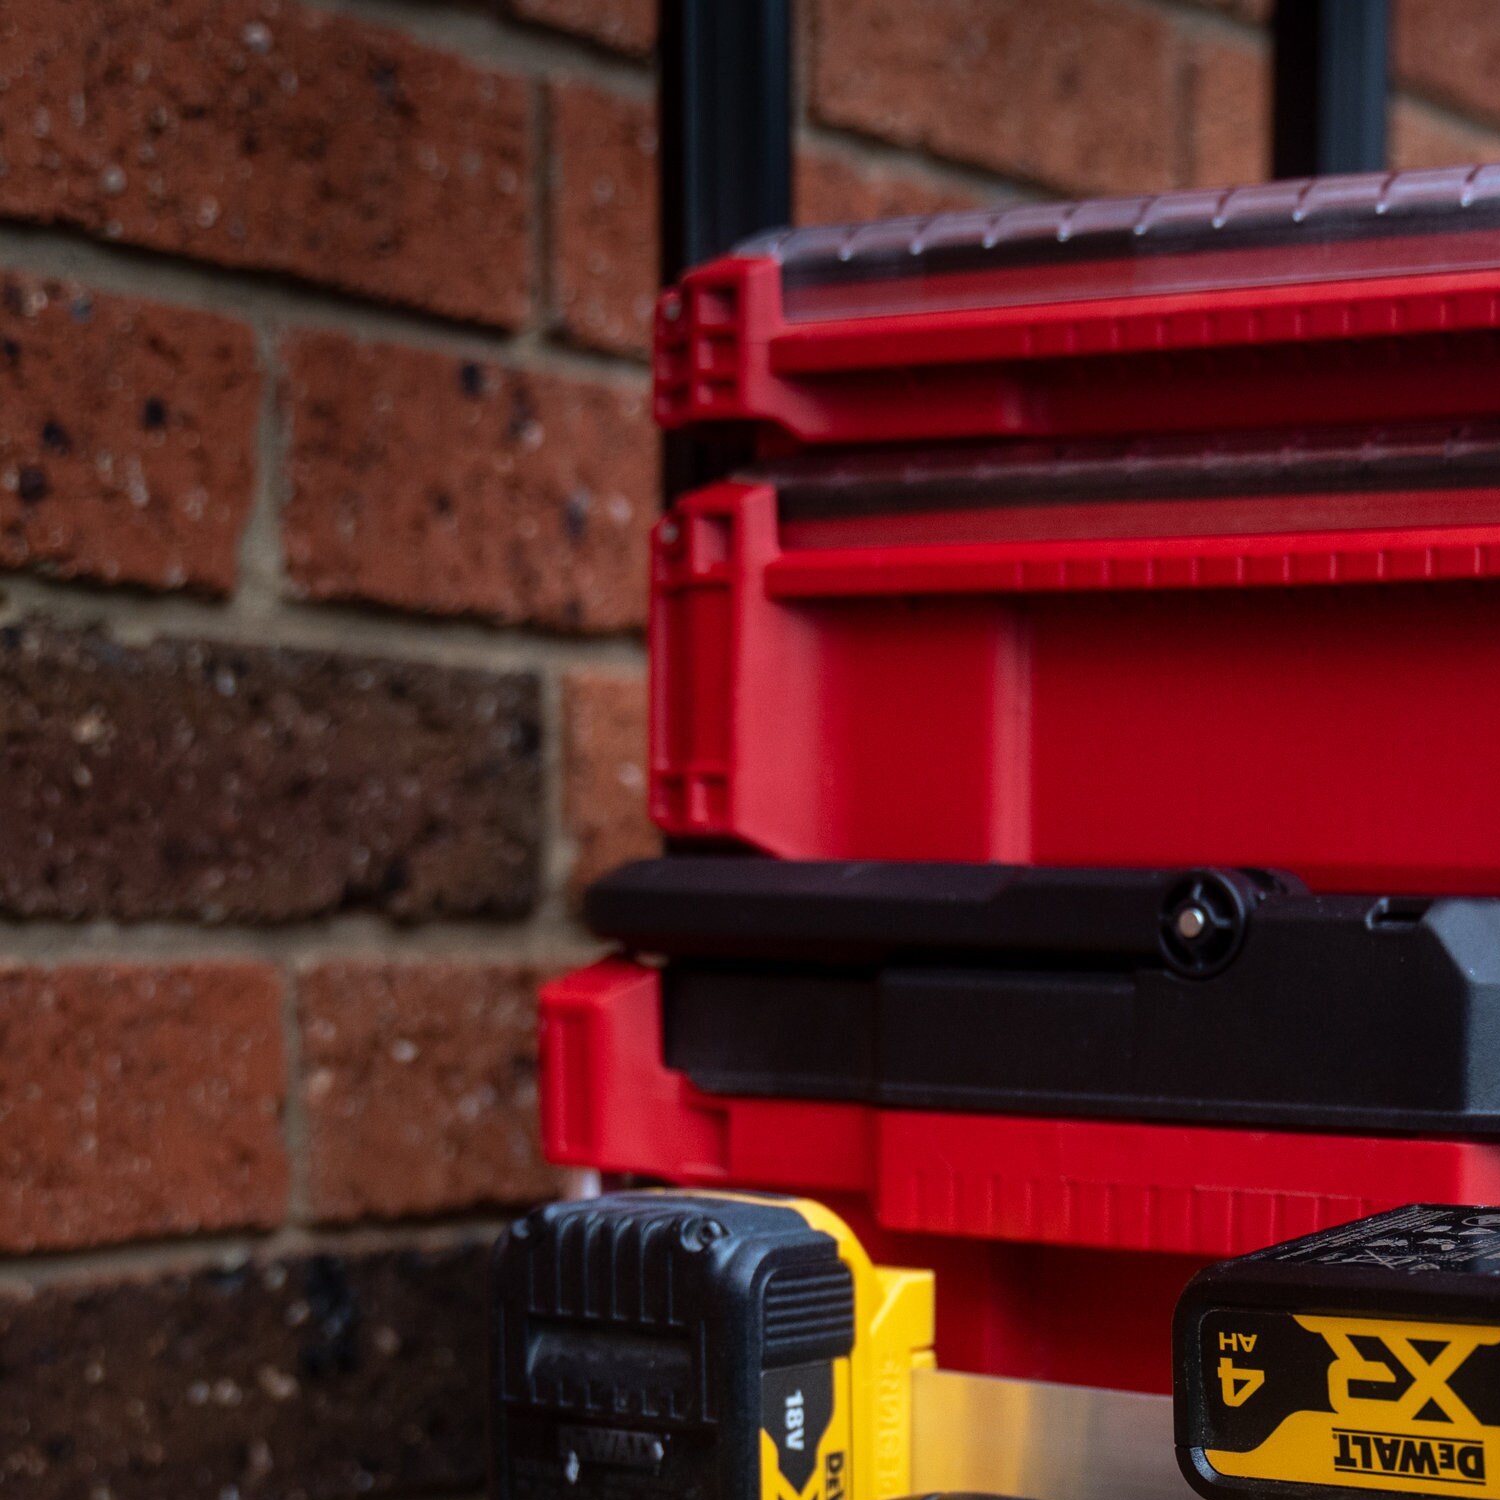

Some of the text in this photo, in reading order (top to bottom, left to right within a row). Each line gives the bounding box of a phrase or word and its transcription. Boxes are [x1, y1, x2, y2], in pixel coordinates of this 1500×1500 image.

[1218, 1332, 1265, 1407] 4 AH
[1320, 1328, 1483, 1427] XR
[784, 1389, 805, 1450] 18V
[1333, 1433, 1487, 1481] DEWALT
